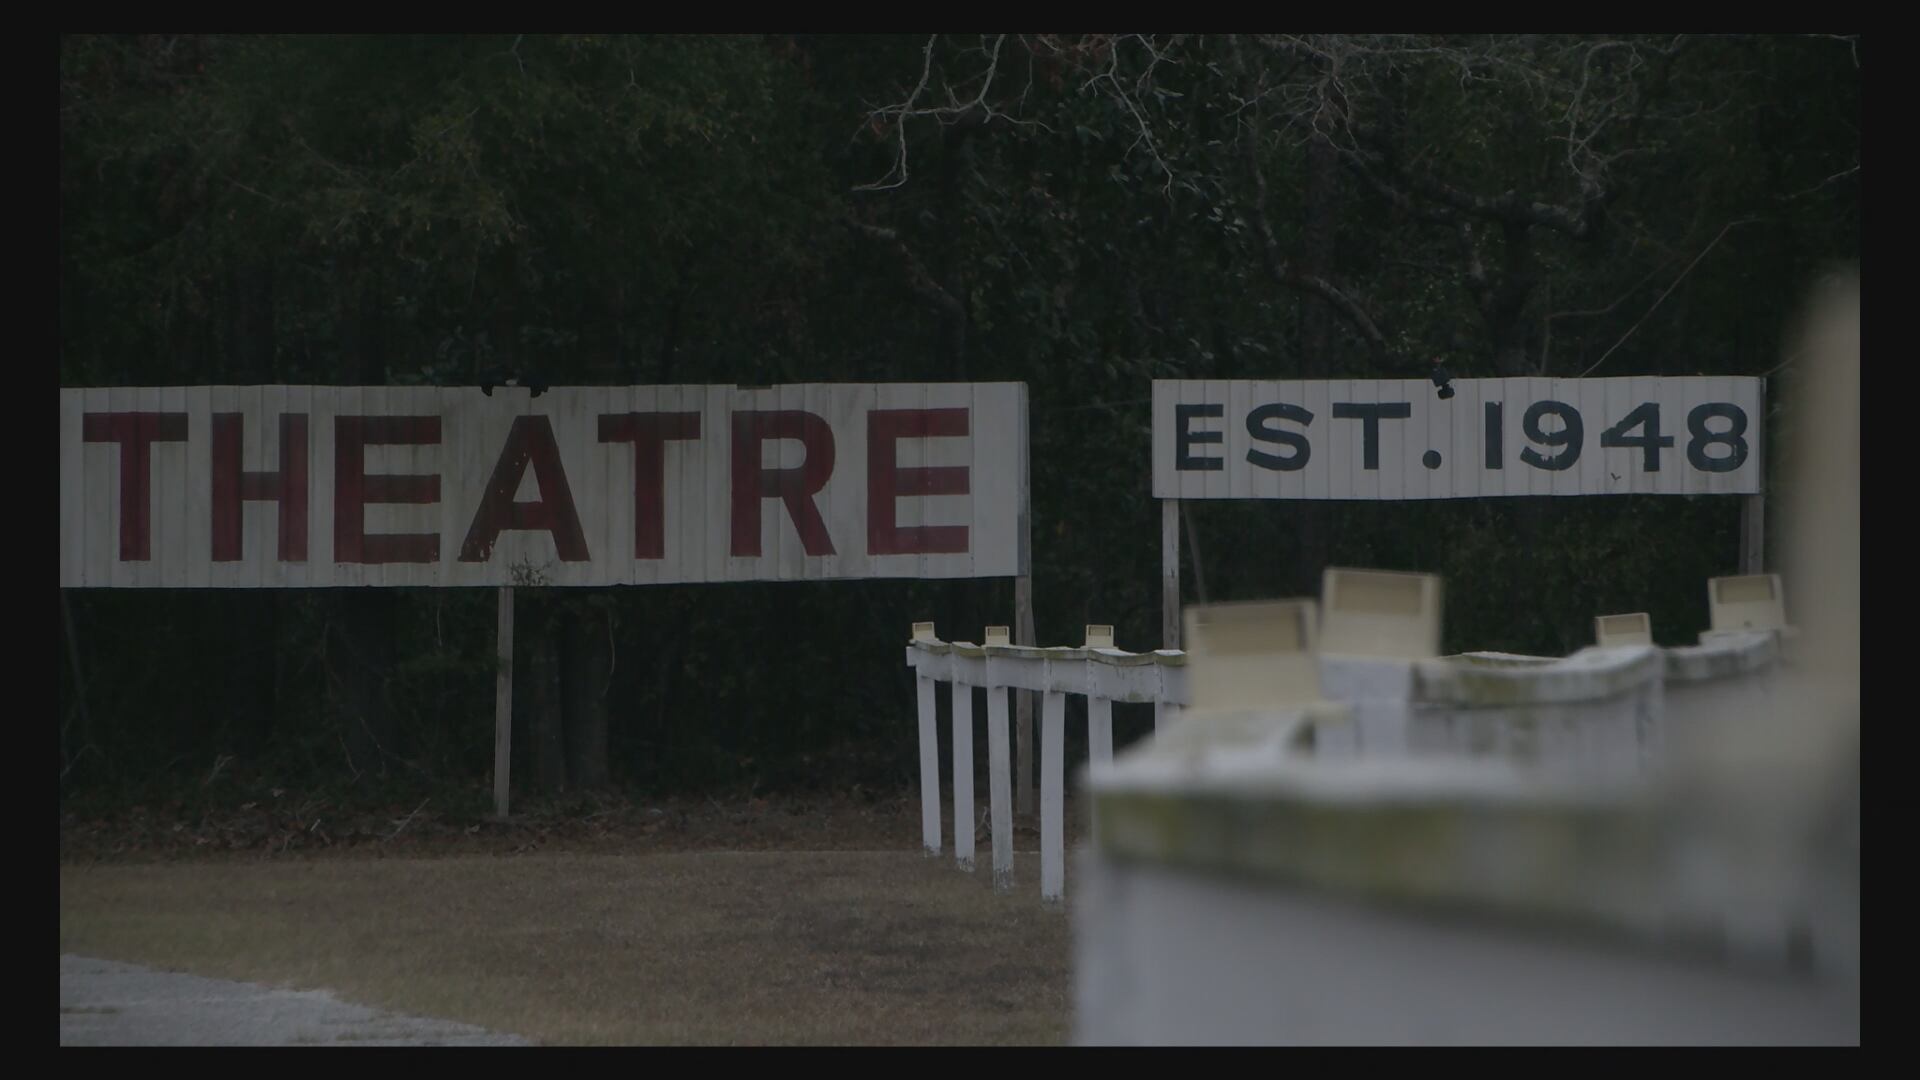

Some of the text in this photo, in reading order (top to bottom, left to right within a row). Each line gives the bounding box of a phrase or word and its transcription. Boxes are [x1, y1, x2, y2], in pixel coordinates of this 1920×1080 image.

[82, 407, 971, 564] THEATRE
[1174, 400, 1749, 473] EST. 1948
